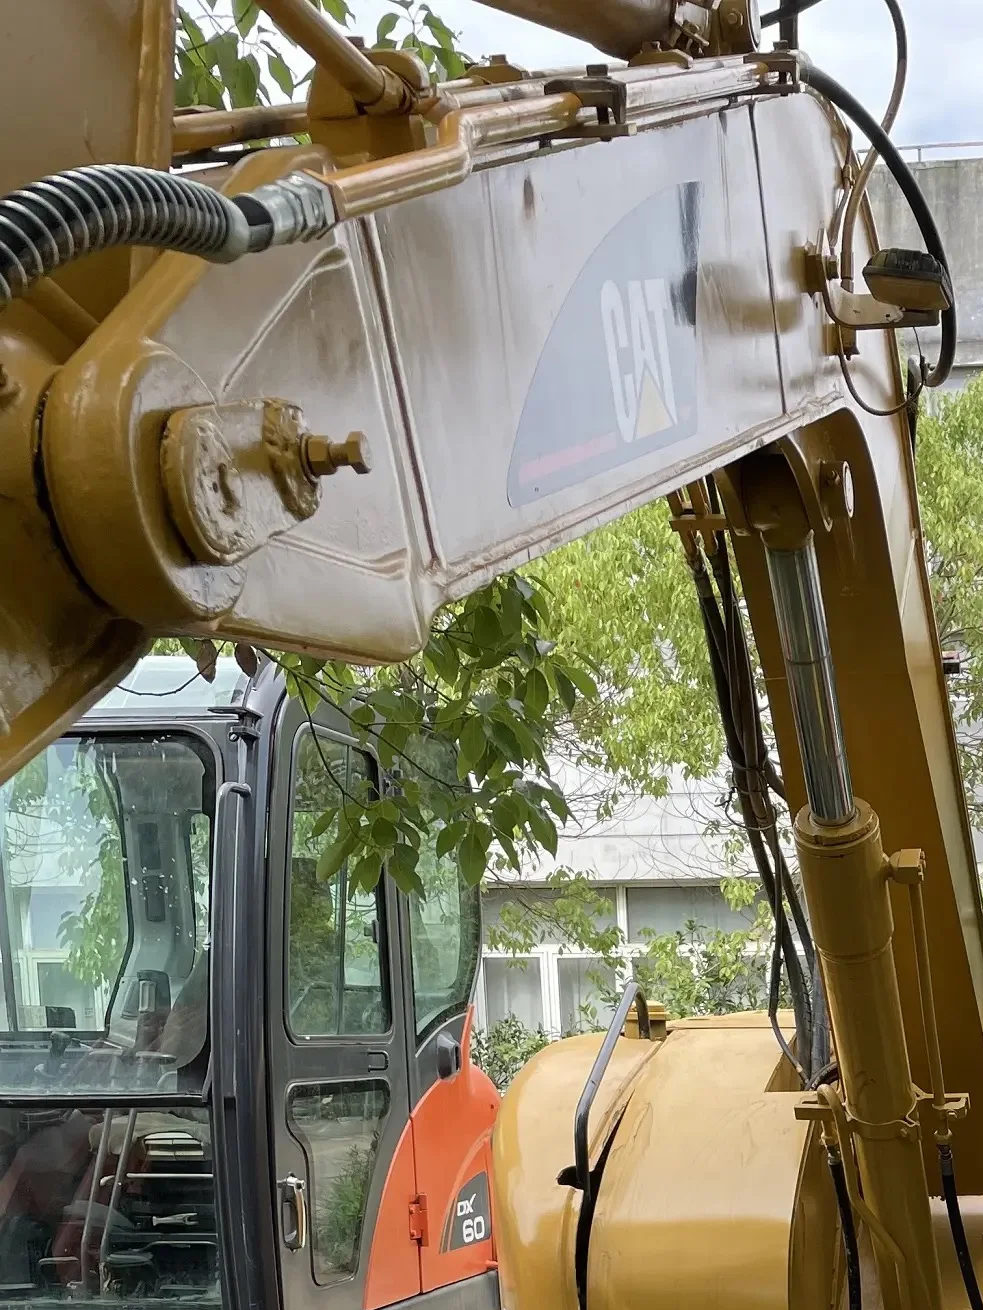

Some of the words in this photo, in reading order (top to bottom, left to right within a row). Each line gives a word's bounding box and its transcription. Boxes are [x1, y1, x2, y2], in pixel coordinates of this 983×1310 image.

[601, 278, 677, 442] CAT
[457, 1193, 476, 1216] DX
[463, 1215, 485, 1243] 60
